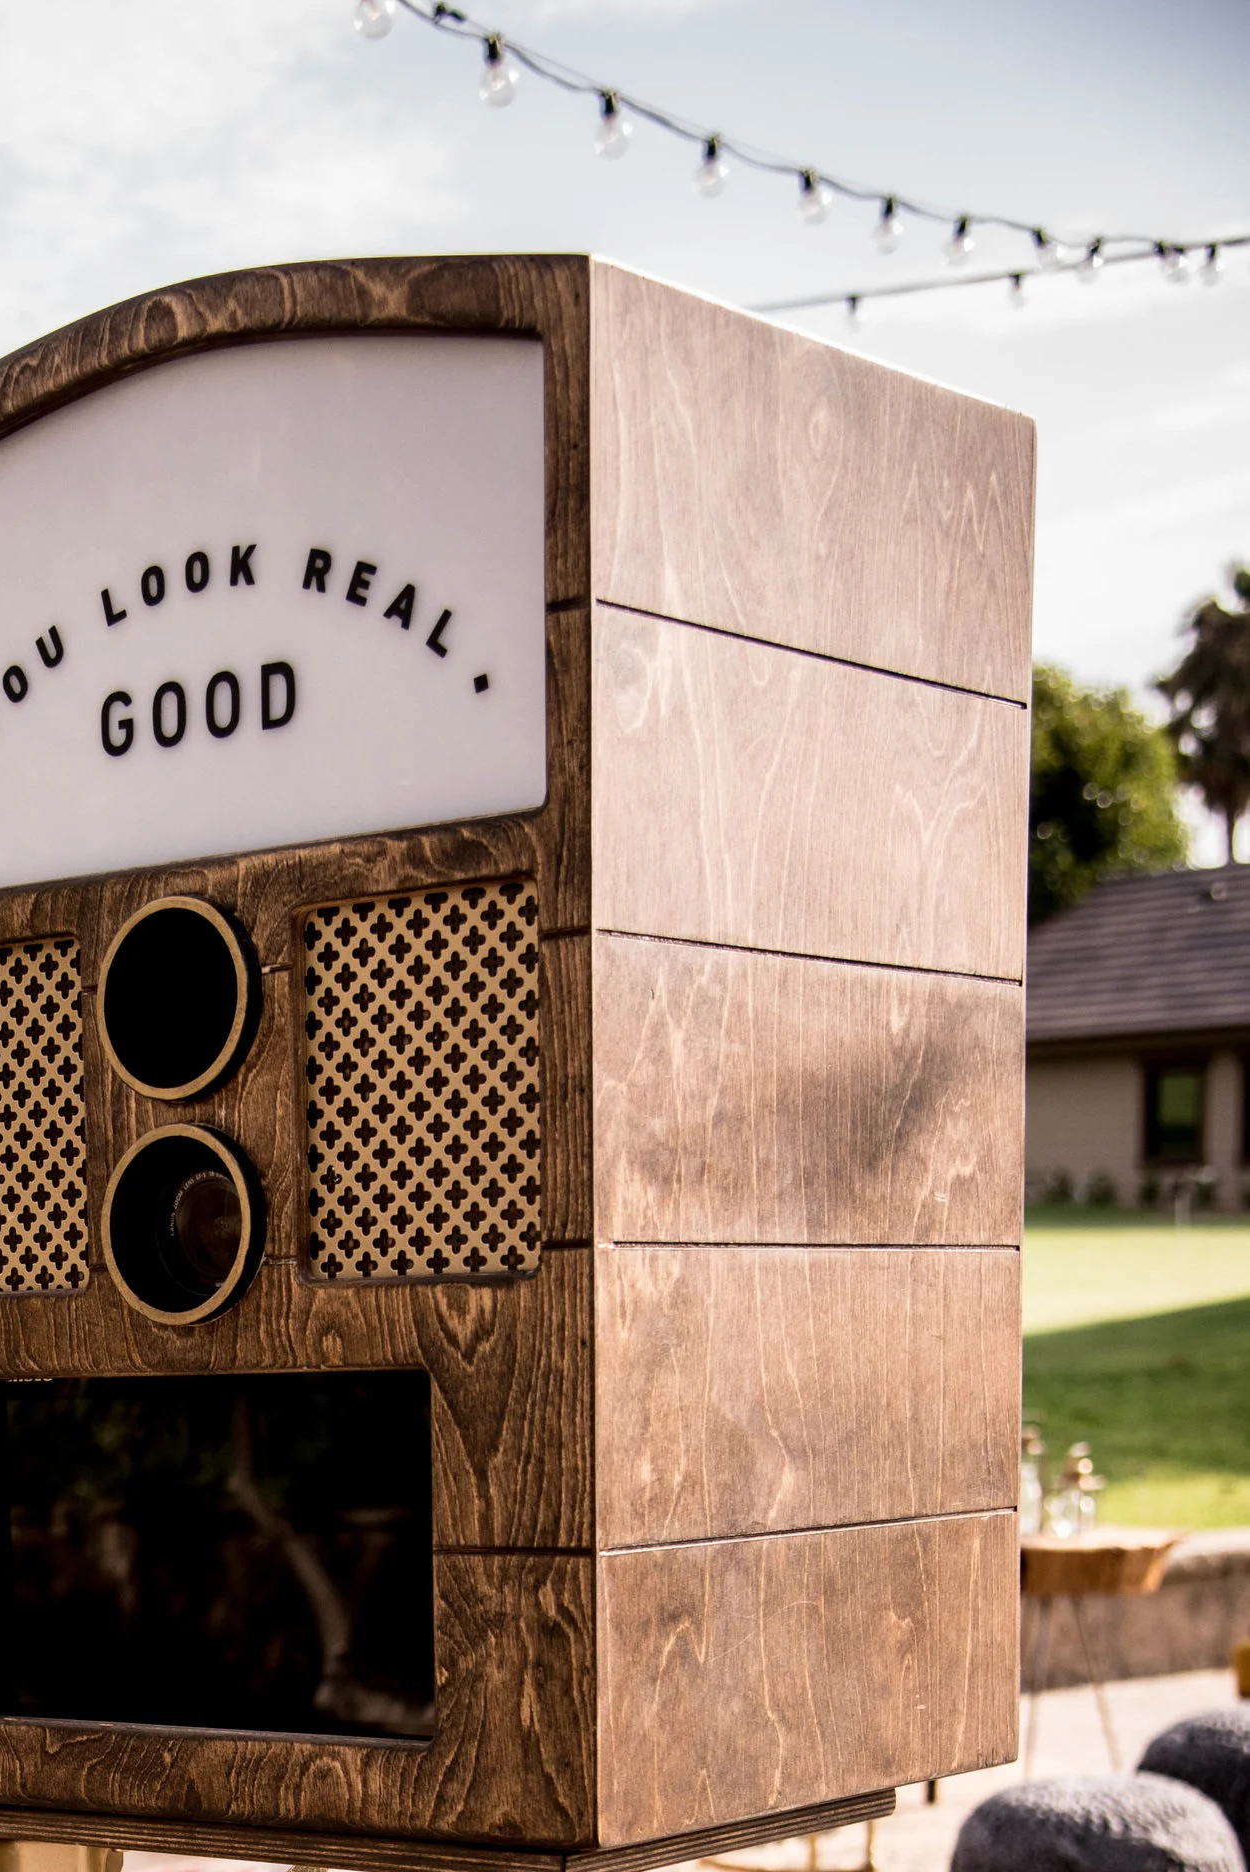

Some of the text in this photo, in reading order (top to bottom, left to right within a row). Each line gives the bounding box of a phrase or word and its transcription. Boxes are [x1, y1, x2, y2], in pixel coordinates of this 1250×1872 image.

[100, 543, 258, 628] LOOK
[302, 547, 454, 659] REAL
[100, 660, 299, 759] GOOD
